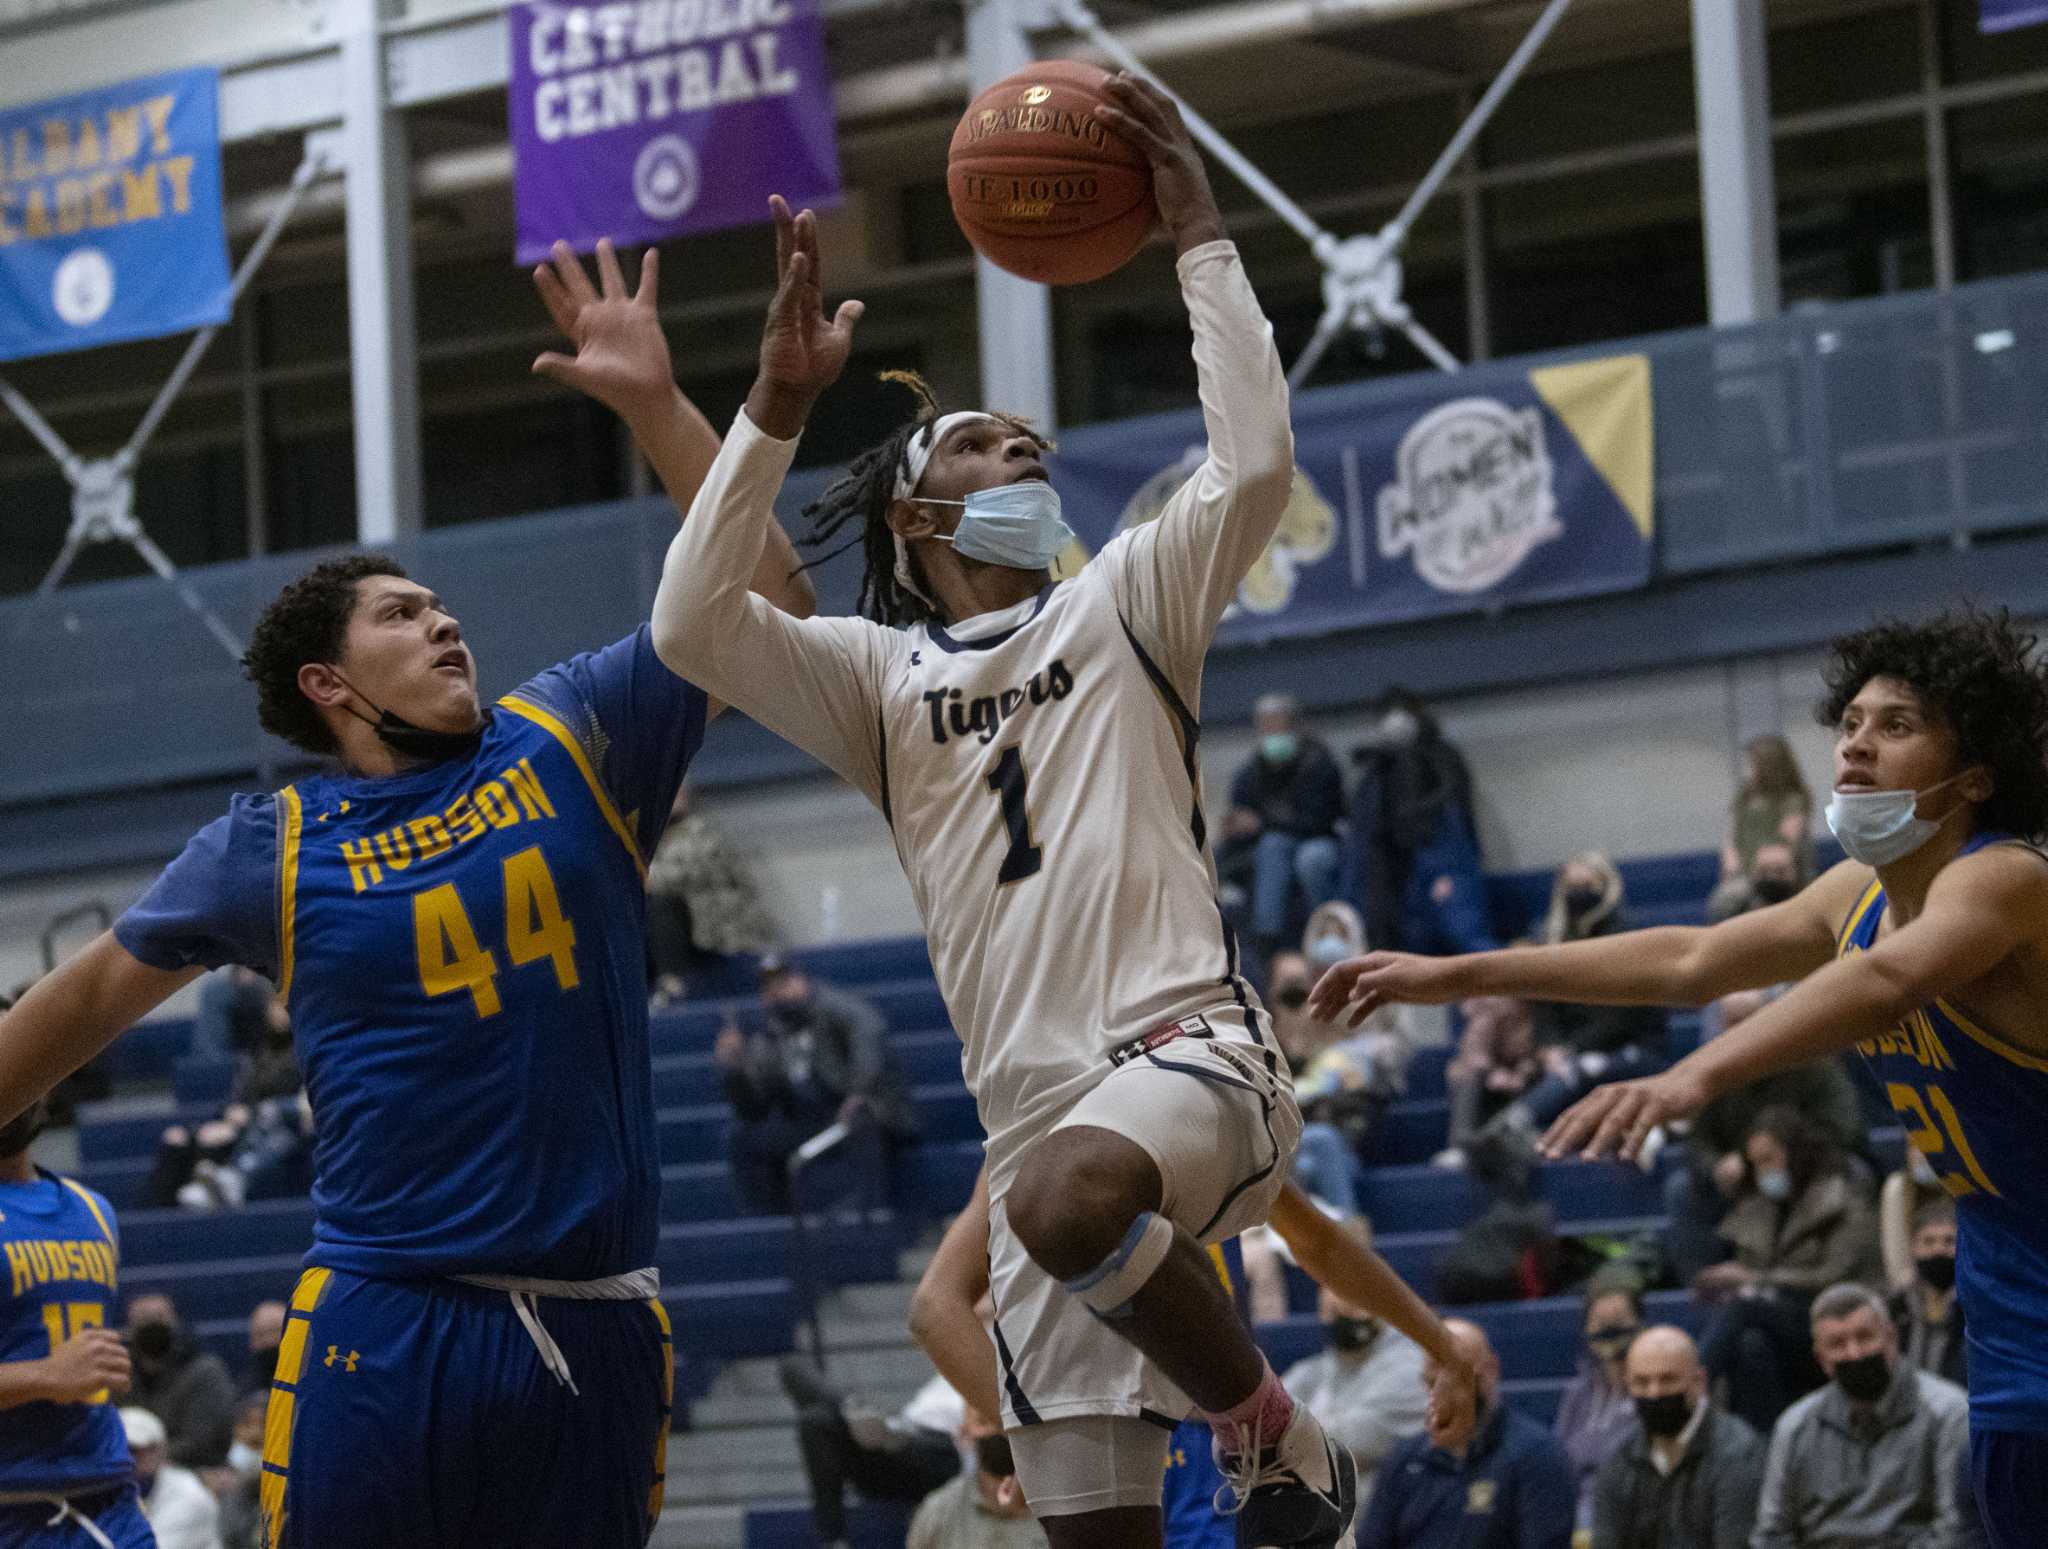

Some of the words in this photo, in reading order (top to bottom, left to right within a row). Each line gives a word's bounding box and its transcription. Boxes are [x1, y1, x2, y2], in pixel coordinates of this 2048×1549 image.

[0, 95, 175, 182] LBANY
[535, 32, 798, 142] CENTRAL
[967, 104, 1110, 151] SPALDING
[922, 658, 1074, 745] Tigers
[339, 757, 558, 895] HUDSON
[984, 741, 1044, 889] 1
[412, 844, 581, 1019] 44
[1886, 1082, 2005, 1199] 21
[4, 1240, 118, 1297] HUDSON
